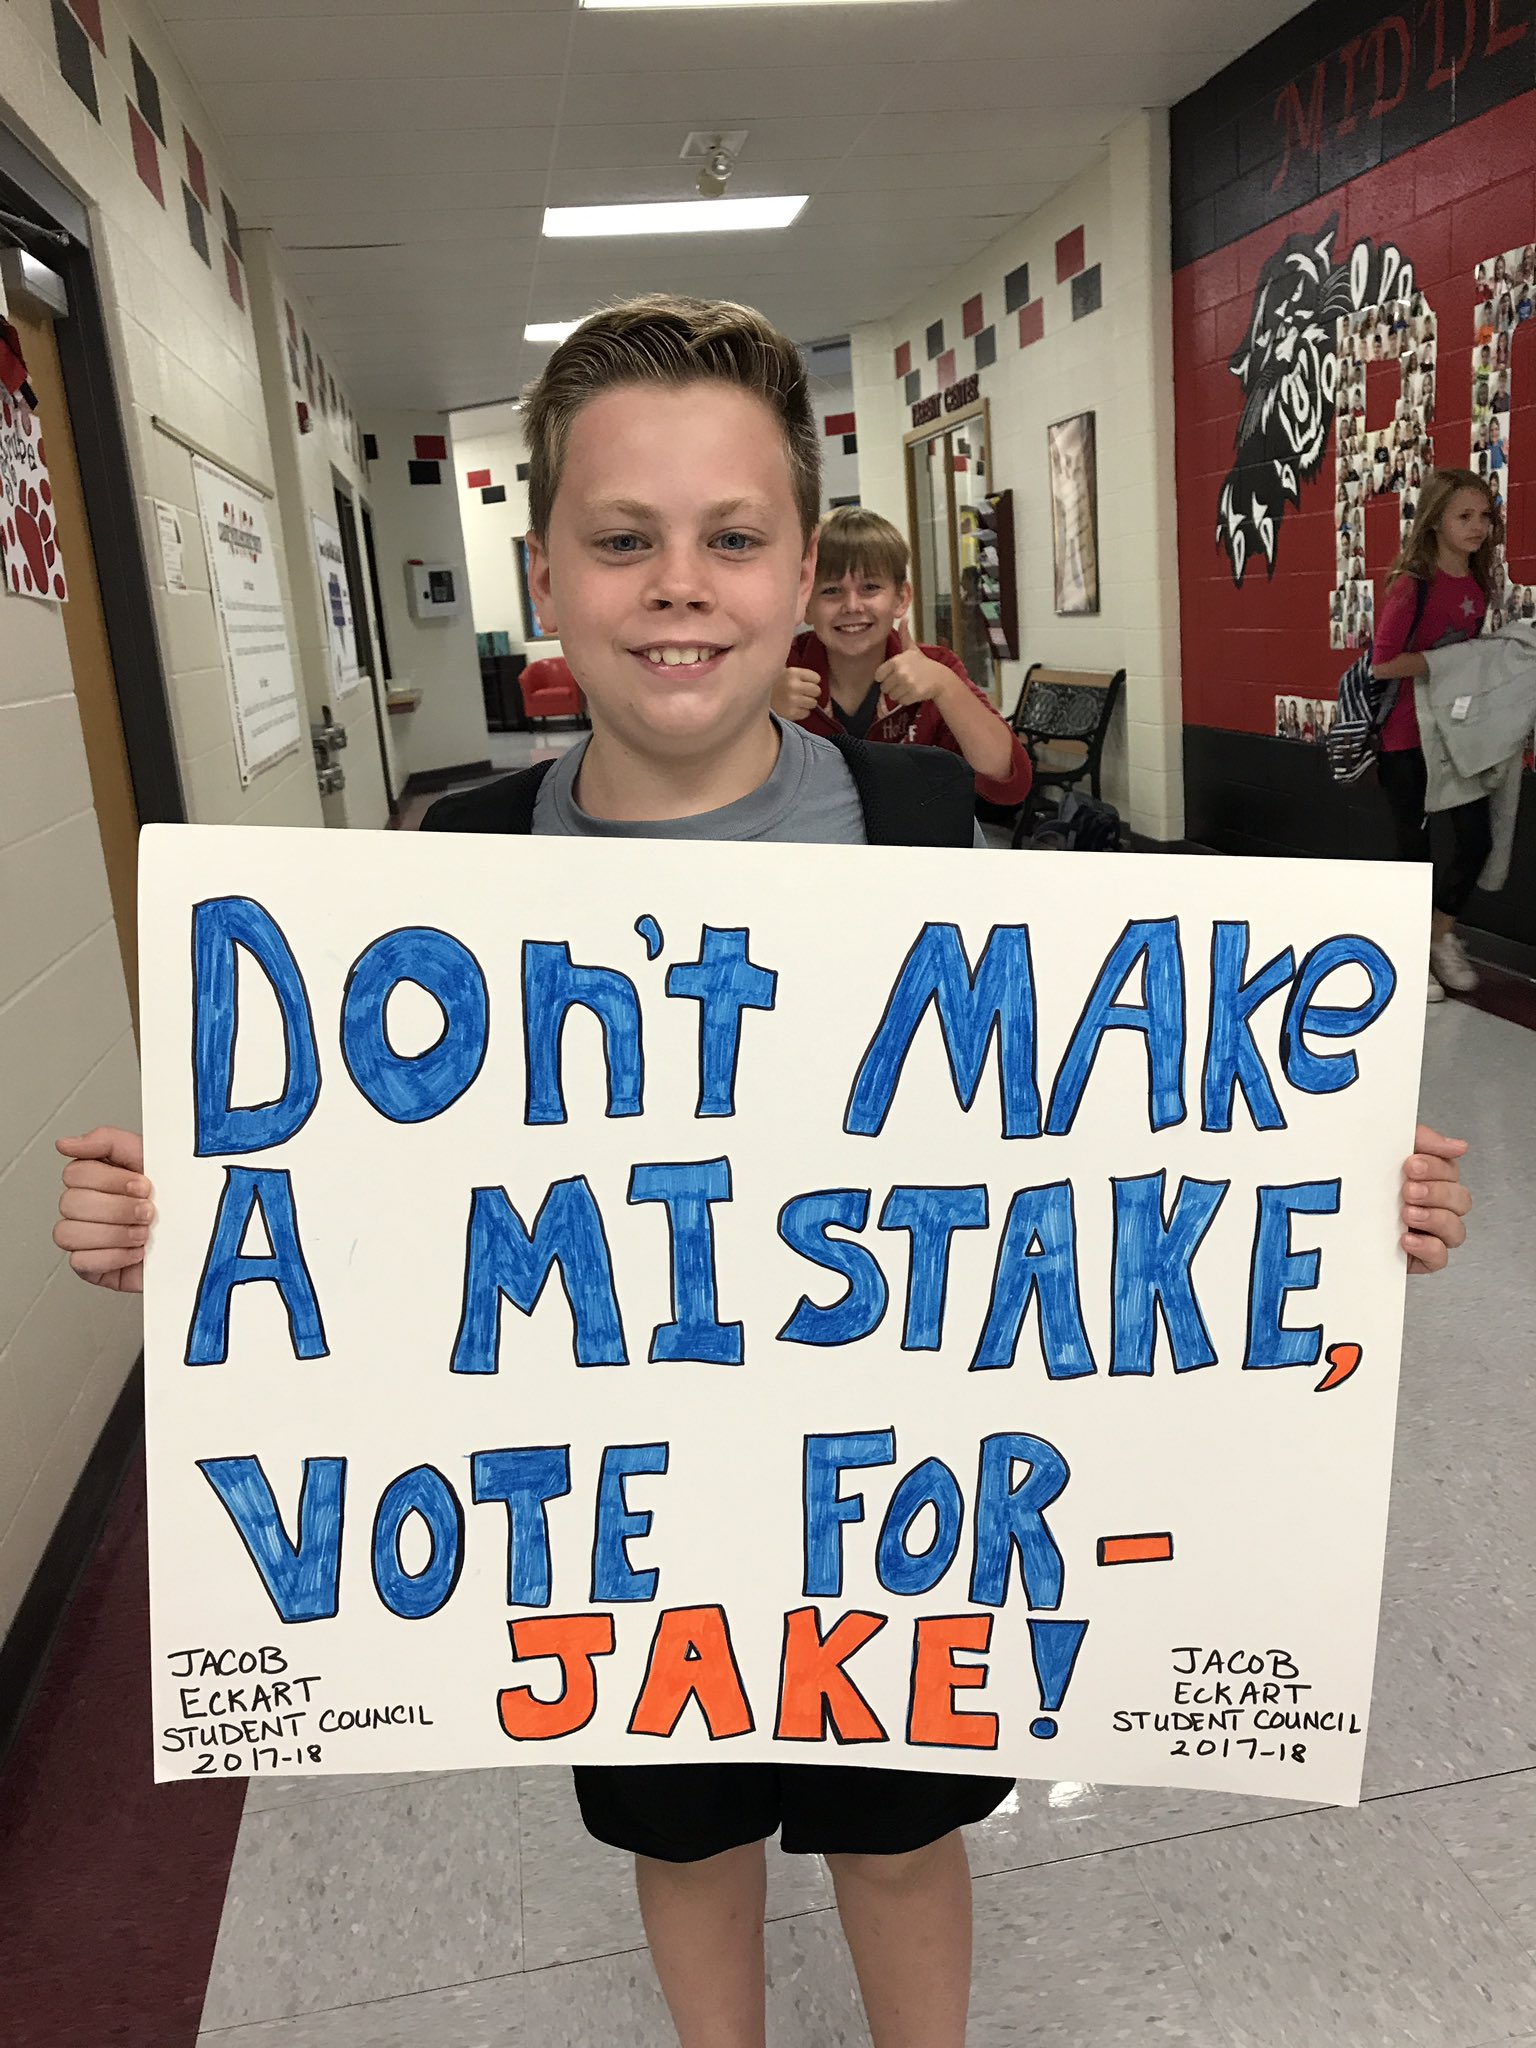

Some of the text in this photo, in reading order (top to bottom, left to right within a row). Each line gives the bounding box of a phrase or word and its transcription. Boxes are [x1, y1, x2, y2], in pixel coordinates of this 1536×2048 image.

[184, 1165, 330, 1366] A
[195, 1442, 669, 1624] VOTE
[167, 1646, 288, 1677] JACOB
[497, 1604, 1090, 1750] JAKE!
[1171, 1647, 1300, 1679] JACOB
[180, 1676, 321, 1719] ECKART
[1174, 1681, 1312, 1705] ECKART
[162, 1705, 434, 1752] STUDENT COUNCIL
[1112, 1709, 1362, 1734] STUDENT COUNCIL
[192, 1744, 322, 1774] 2017-18
[1170, 1738, 1307, 1764] 2017-18
